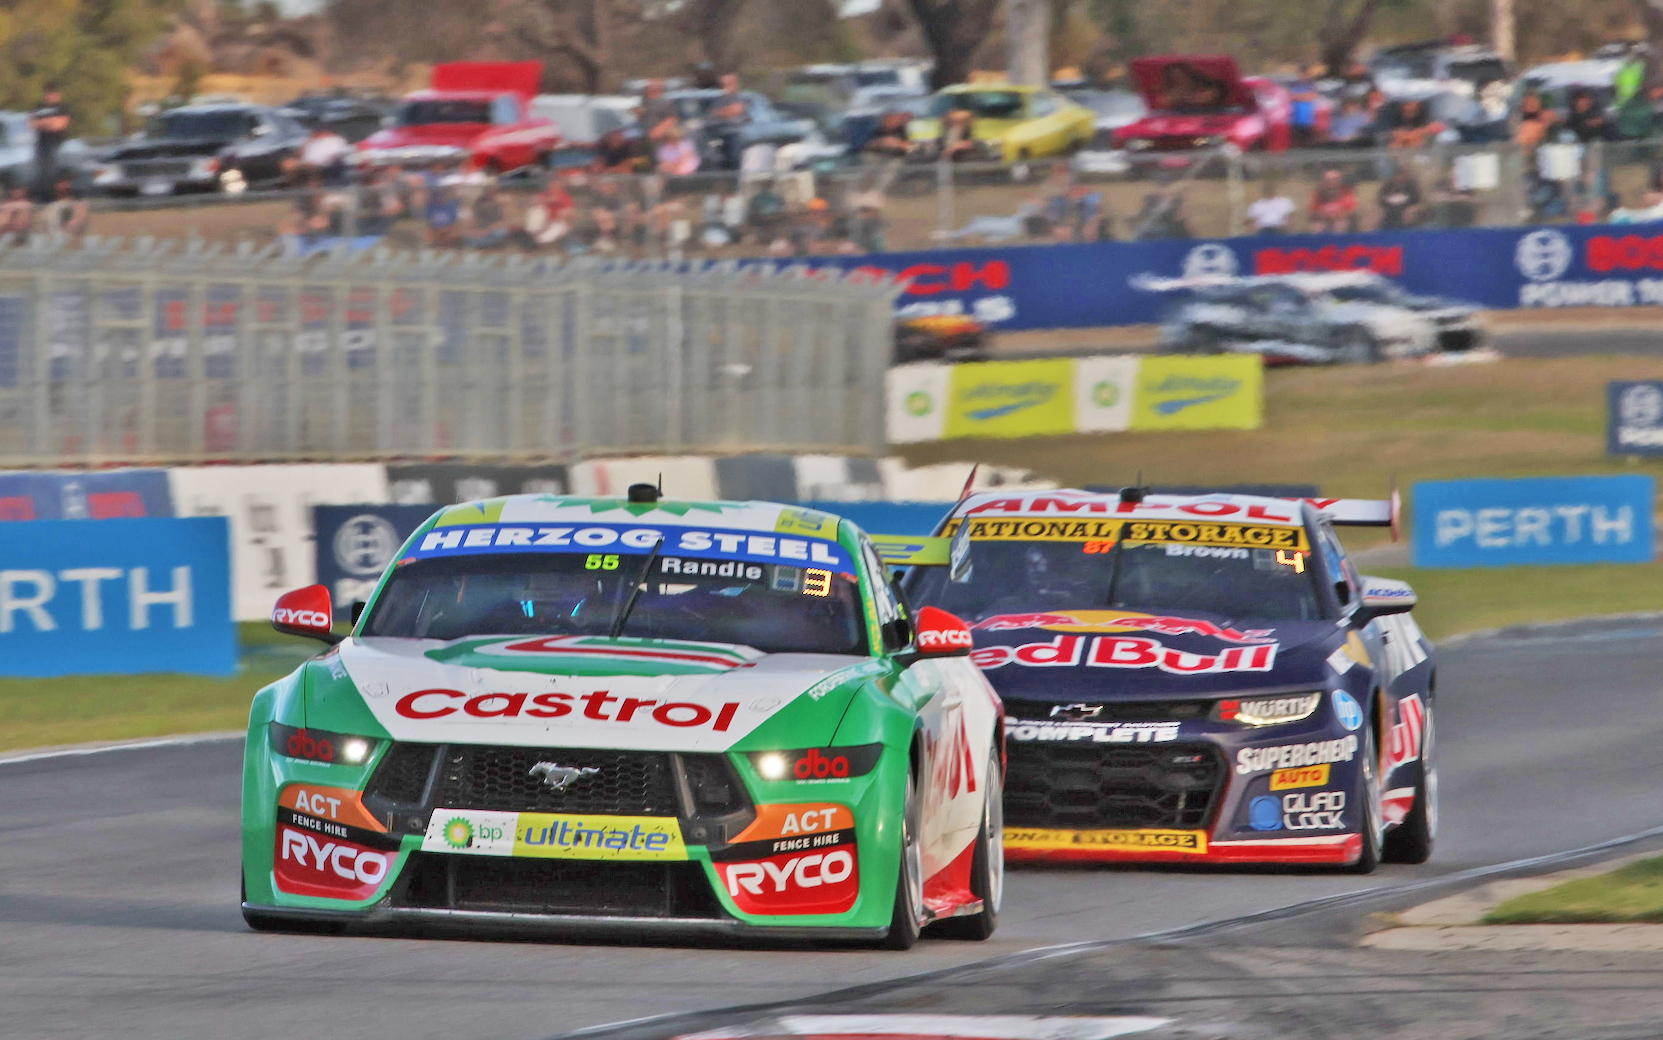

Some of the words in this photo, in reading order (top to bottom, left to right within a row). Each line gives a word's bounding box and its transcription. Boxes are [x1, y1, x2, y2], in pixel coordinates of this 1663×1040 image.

[964, 497, 1291, 522] AMPOL
[1130, 523, 1294, 547] STORAGE
[1435, 504, 1633, 548] PERTH
[420, 527, 663, 552] HERZOG
[678, 531, 839, 565] STEEL
[1165, 544, 1250, 560] Brown
[584, 554, 620, 571] 55
[661, 556, 762, 580] Randle
[271, 609, 329, 627] RYCO
[918, 629, 972, 647] RYCO
[969, 635, 1086, 671] ed
[1085, 636, 1281, 675] Bull
[394, 688, 740, 732] Castrol
[287, 728, 334, 762] dba
[1236, 734, 1358, 775] SUPERCHEAP
[794, 748, 849, 779] dba
[1276, 770, 1323, 785] AUTO
[295, 790, 341, 819] ACT
[1282, 791, 1346, 813] QUAD
[292, 814, 322, 831] FENCE
[324, 822, 348, 839] HIRE
[781, 807, 837, 835] ACT
[1283, 811, 1346, 830] LOCK
[479, 824, 503, 843] bp
[525, 821, 669, 851] ultimate
[773, 837, 810, 852] FENCE
[813, 833, 840, 847] HIRE
[282, 829, 387, 885] RYCO
[726, 850, 853, 896] RYCO
